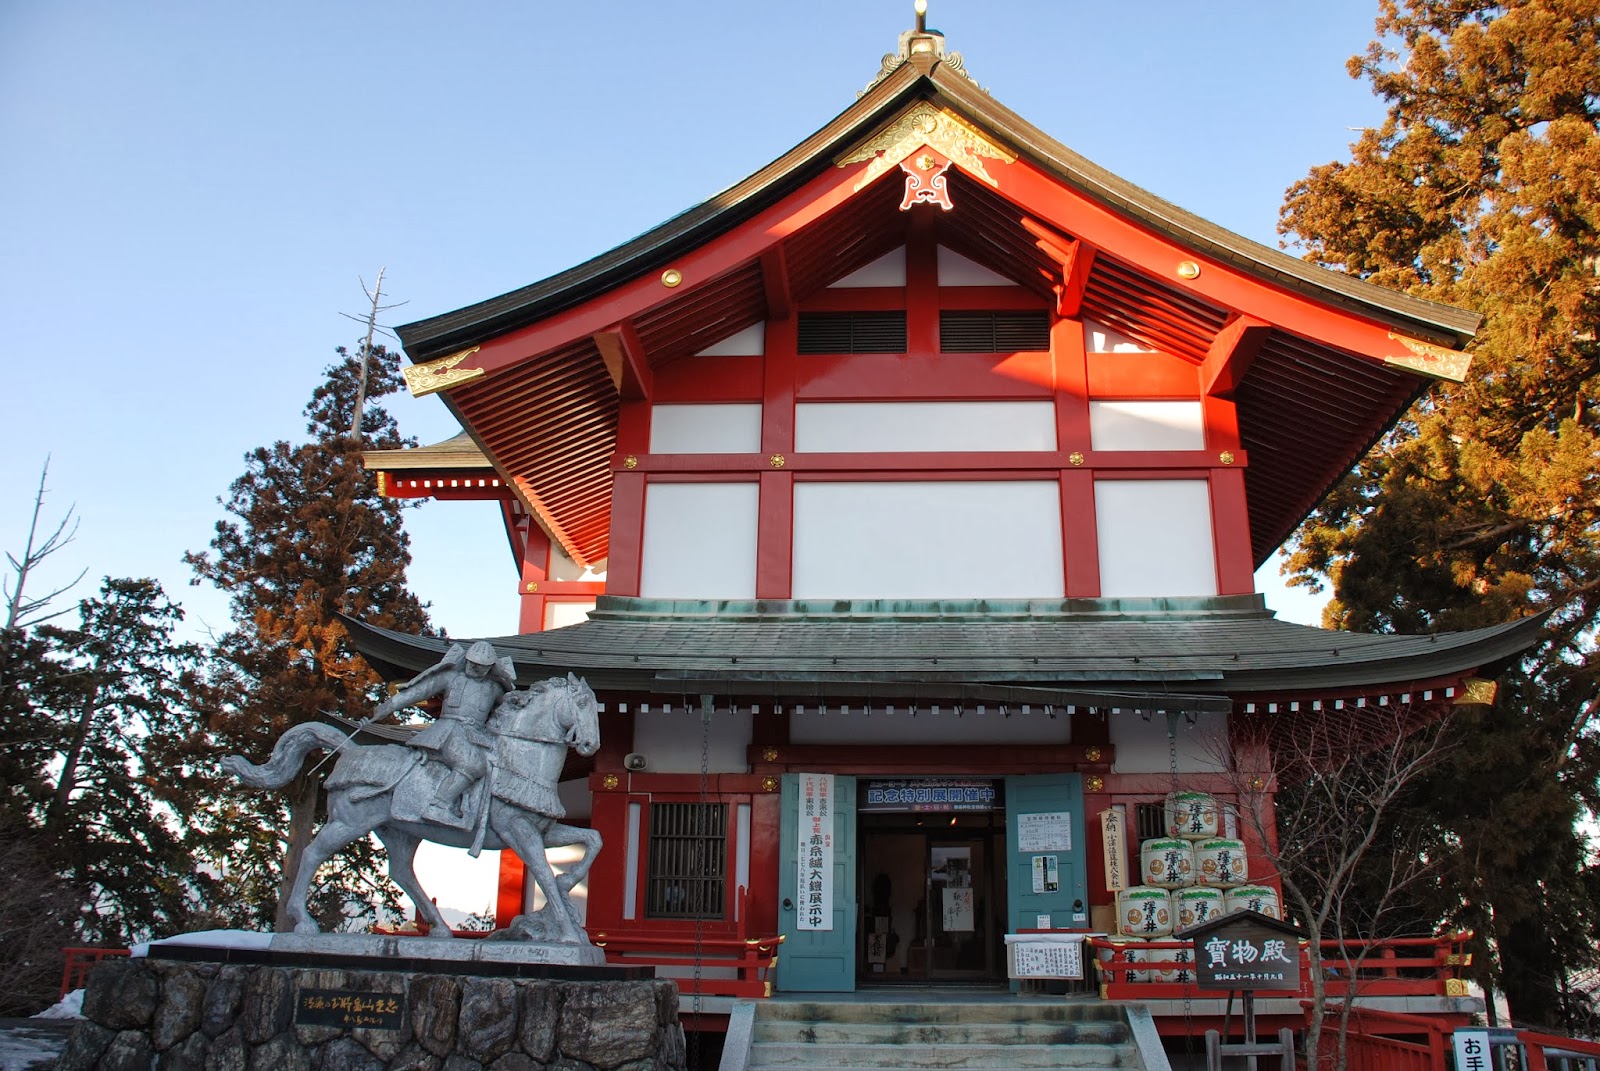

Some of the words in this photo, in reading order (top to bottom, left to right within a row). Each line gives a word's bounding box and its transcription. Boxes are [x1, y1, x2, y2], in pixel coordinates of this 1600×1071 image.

[867, 788, 995, 803] 記念特別展開催中
[1105, 811, 1118, 832] 奉納
[1204, 936, 1292, 969] 寶物殿
